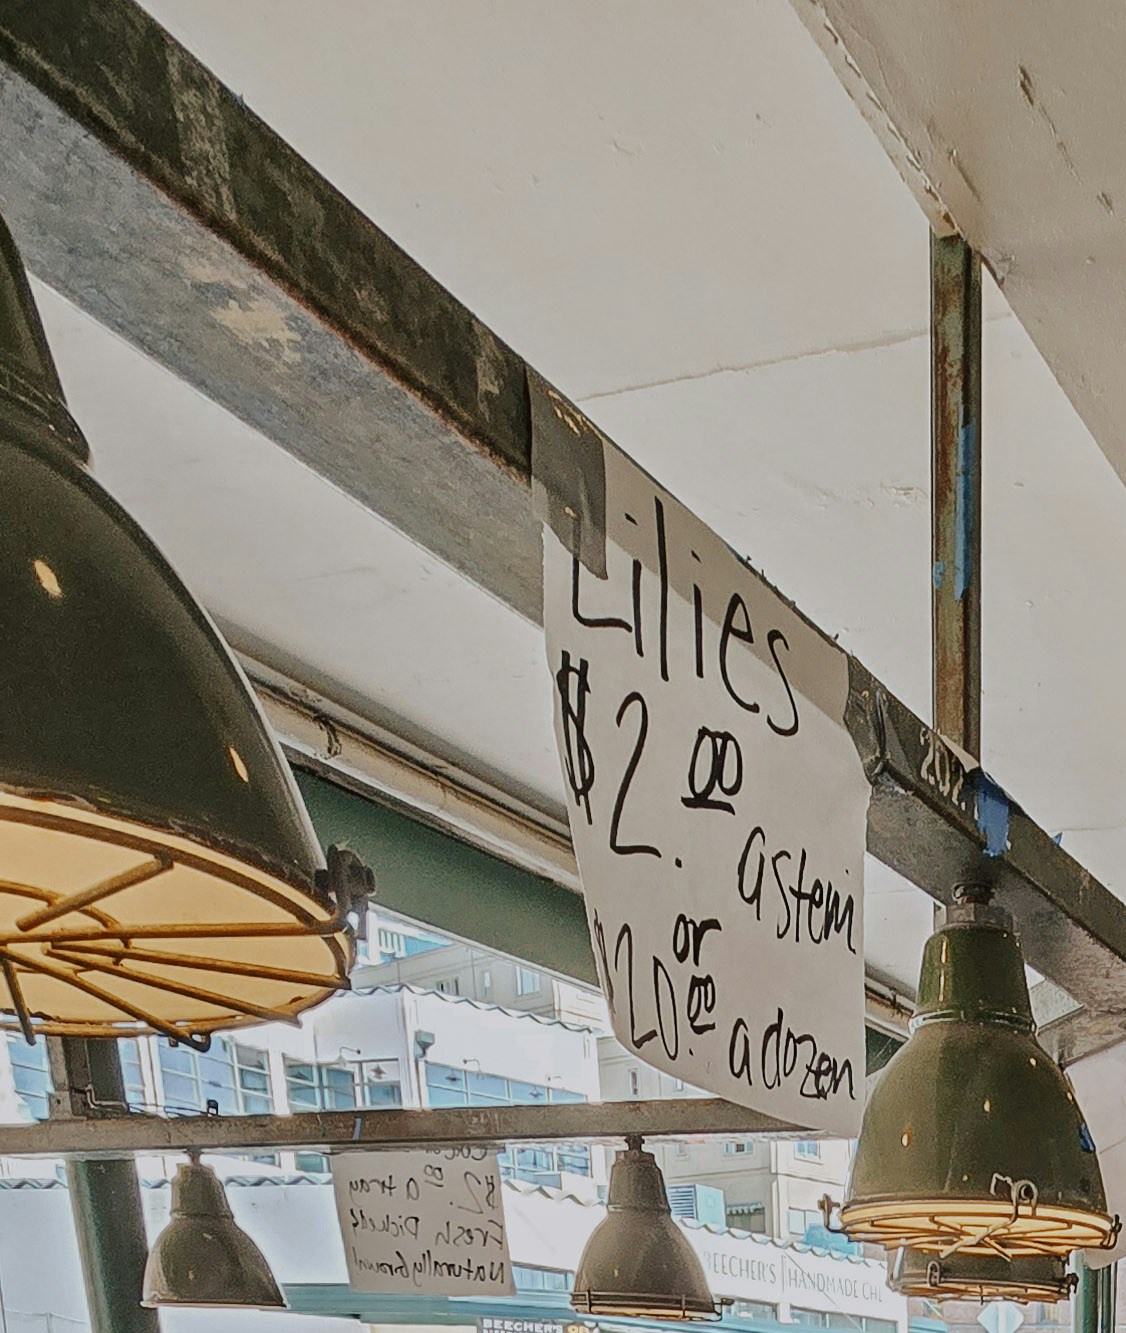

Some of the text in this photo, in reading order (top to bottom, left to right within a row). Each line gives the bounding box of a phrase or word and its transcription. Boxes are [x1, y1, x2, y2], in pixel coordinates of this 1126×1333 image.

[571, 497, 799, 736] Lilies
[674, 914, 721, 966] or
[788, 1268, 859, 1299] HANDMADE
[483, 1319, 563, 1333] BEECHER'S
